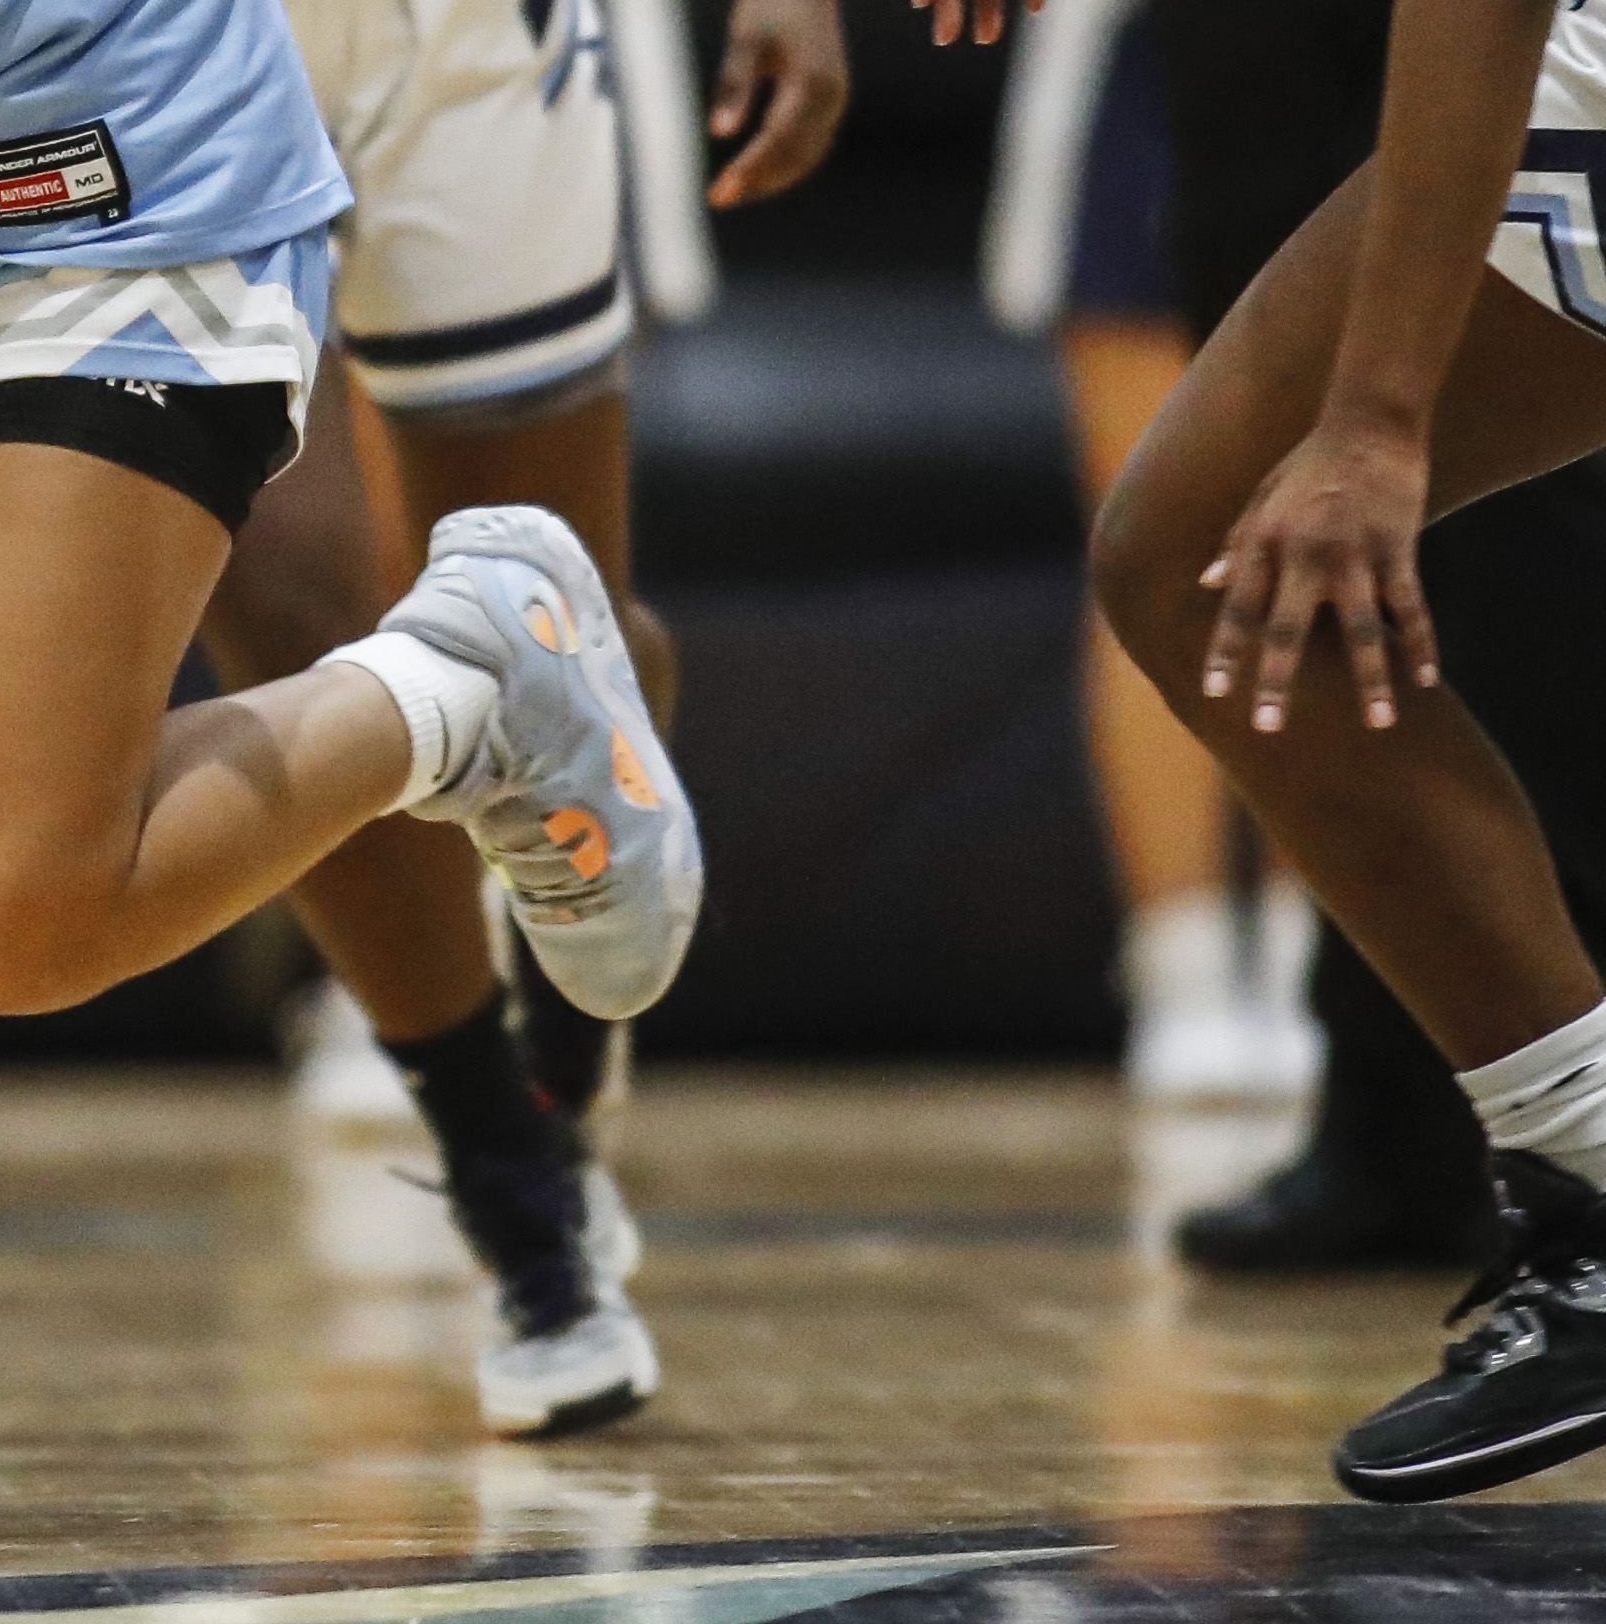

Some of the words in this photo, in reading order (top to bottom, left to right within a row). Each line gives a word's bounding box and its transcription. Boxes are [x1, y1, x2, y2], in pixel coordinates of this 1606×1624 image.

[36, 144, 96, 166] ARMOUR
[0, 180, 64, 204] AUTHENTIC
[74, 172, 105, 189] MD
